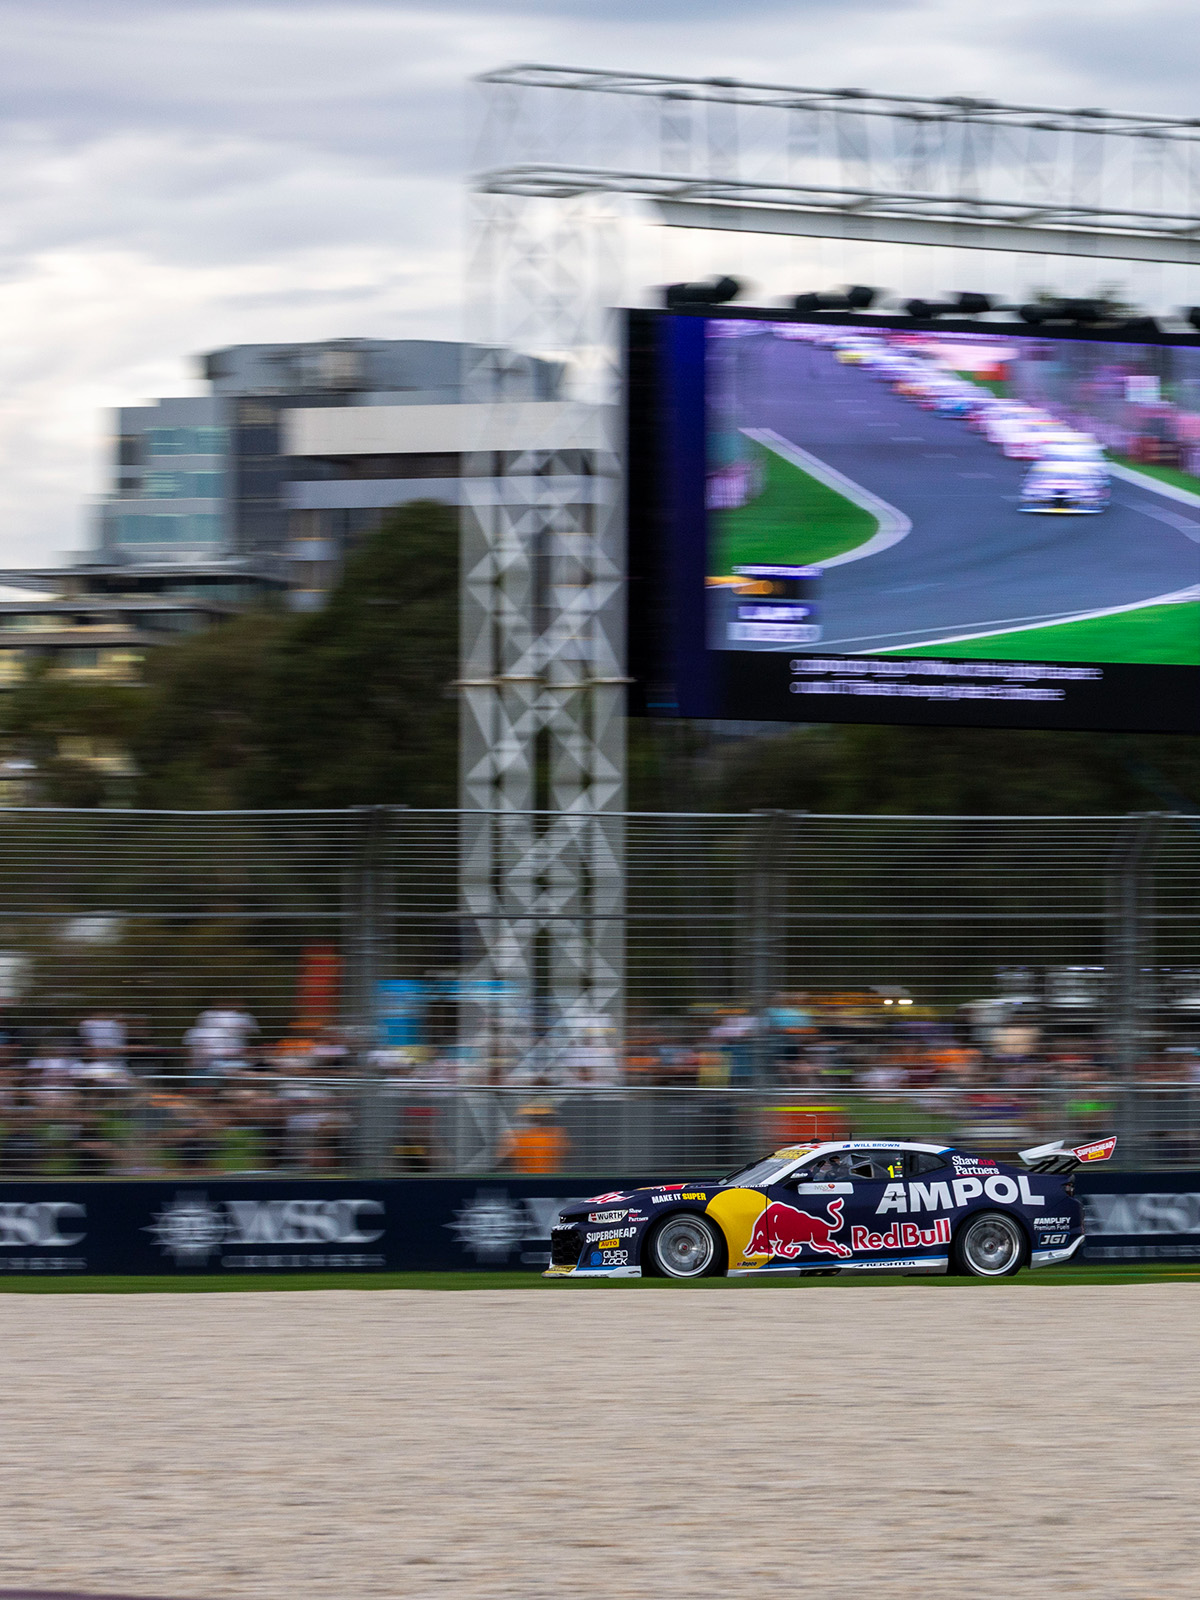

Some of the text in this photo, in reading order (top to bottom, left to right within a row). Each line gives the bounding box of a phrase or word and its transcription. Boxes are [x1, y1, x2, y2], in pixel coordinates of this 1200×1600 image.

[1077, 1140, 1114, 1157] SUPERCHEAP
[952, 1155, 996, 1166] Shaw and
[887, 1165, 895, 1178] 1
[955, 1165, 1000, 1175] Partners
[651, 1192, 707, 1204] MAKE IT SUPER
[875, 1175, 1045, 1214] AMPOL
[597, 1211, 623, 1221] WÜRTH
[585, 1227, 637, 1243] SUPERCHEAP
[600, 1240, 618, 1248] AUTO
[603, 1249, 629, 1259] QUAD
[602, 1258, 629, 1266] LOCK
